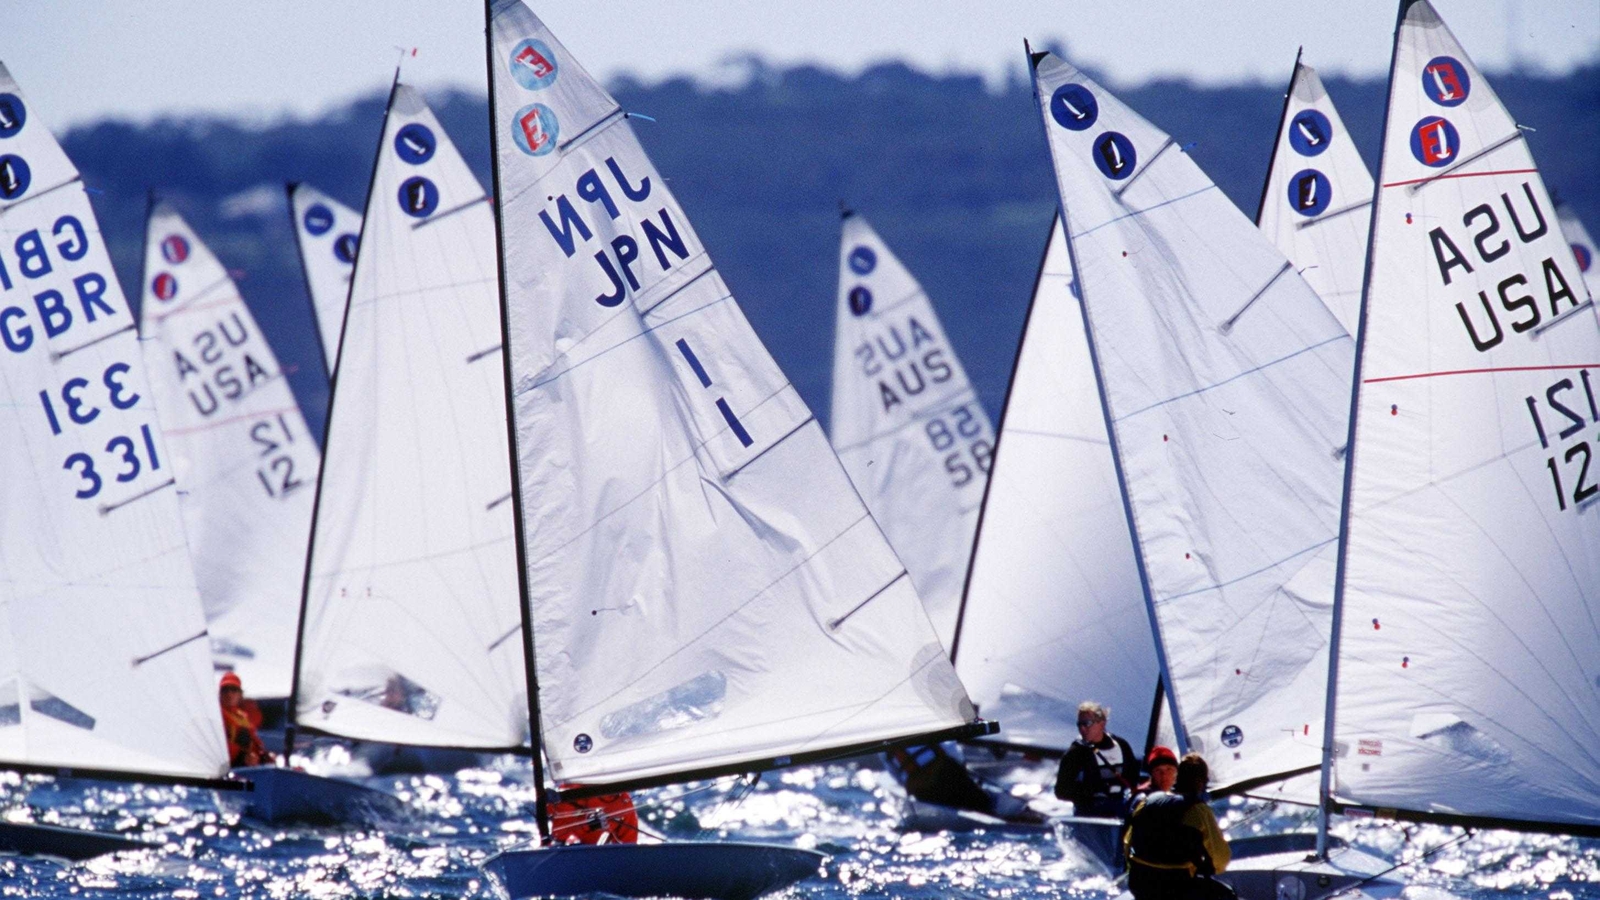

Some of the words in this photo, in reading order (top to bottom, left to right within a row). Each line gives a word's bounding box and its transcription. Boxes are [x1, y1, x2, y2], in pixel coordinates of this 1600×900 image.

[594, 208, 690, 307] JPN
[0, 271, 117, 353] GBR
[1455, 257, 1579, 352] USA
[187, 354, 269, 417] USA
[878, 349, 954, 413] AUS
[63, 423, 160, 499] 331
[256, 455, 302, 498] 12
[1547, 431, 1600, 512] 12
